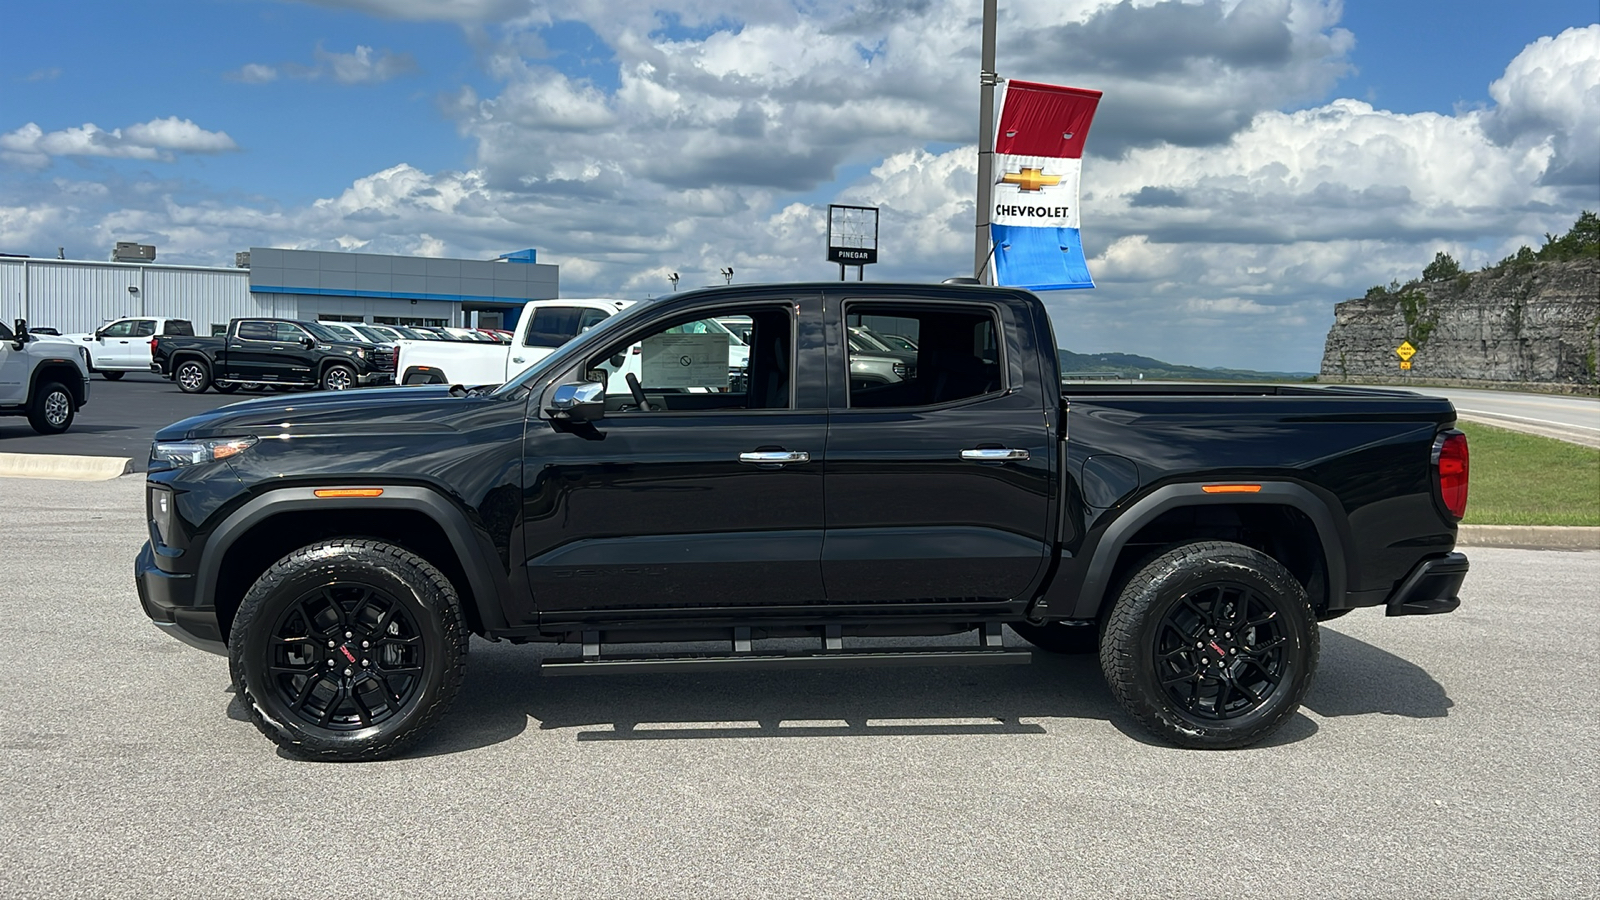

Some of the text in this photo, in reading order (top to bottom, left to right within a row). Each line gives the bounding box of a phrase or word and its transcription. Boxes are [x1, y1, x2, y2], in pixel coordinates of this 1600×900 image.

[838, 250, 868, 259] PINEGAR
[339, 645, 356, 663] GMC
[1209, 641, 1226, 656] GMC
